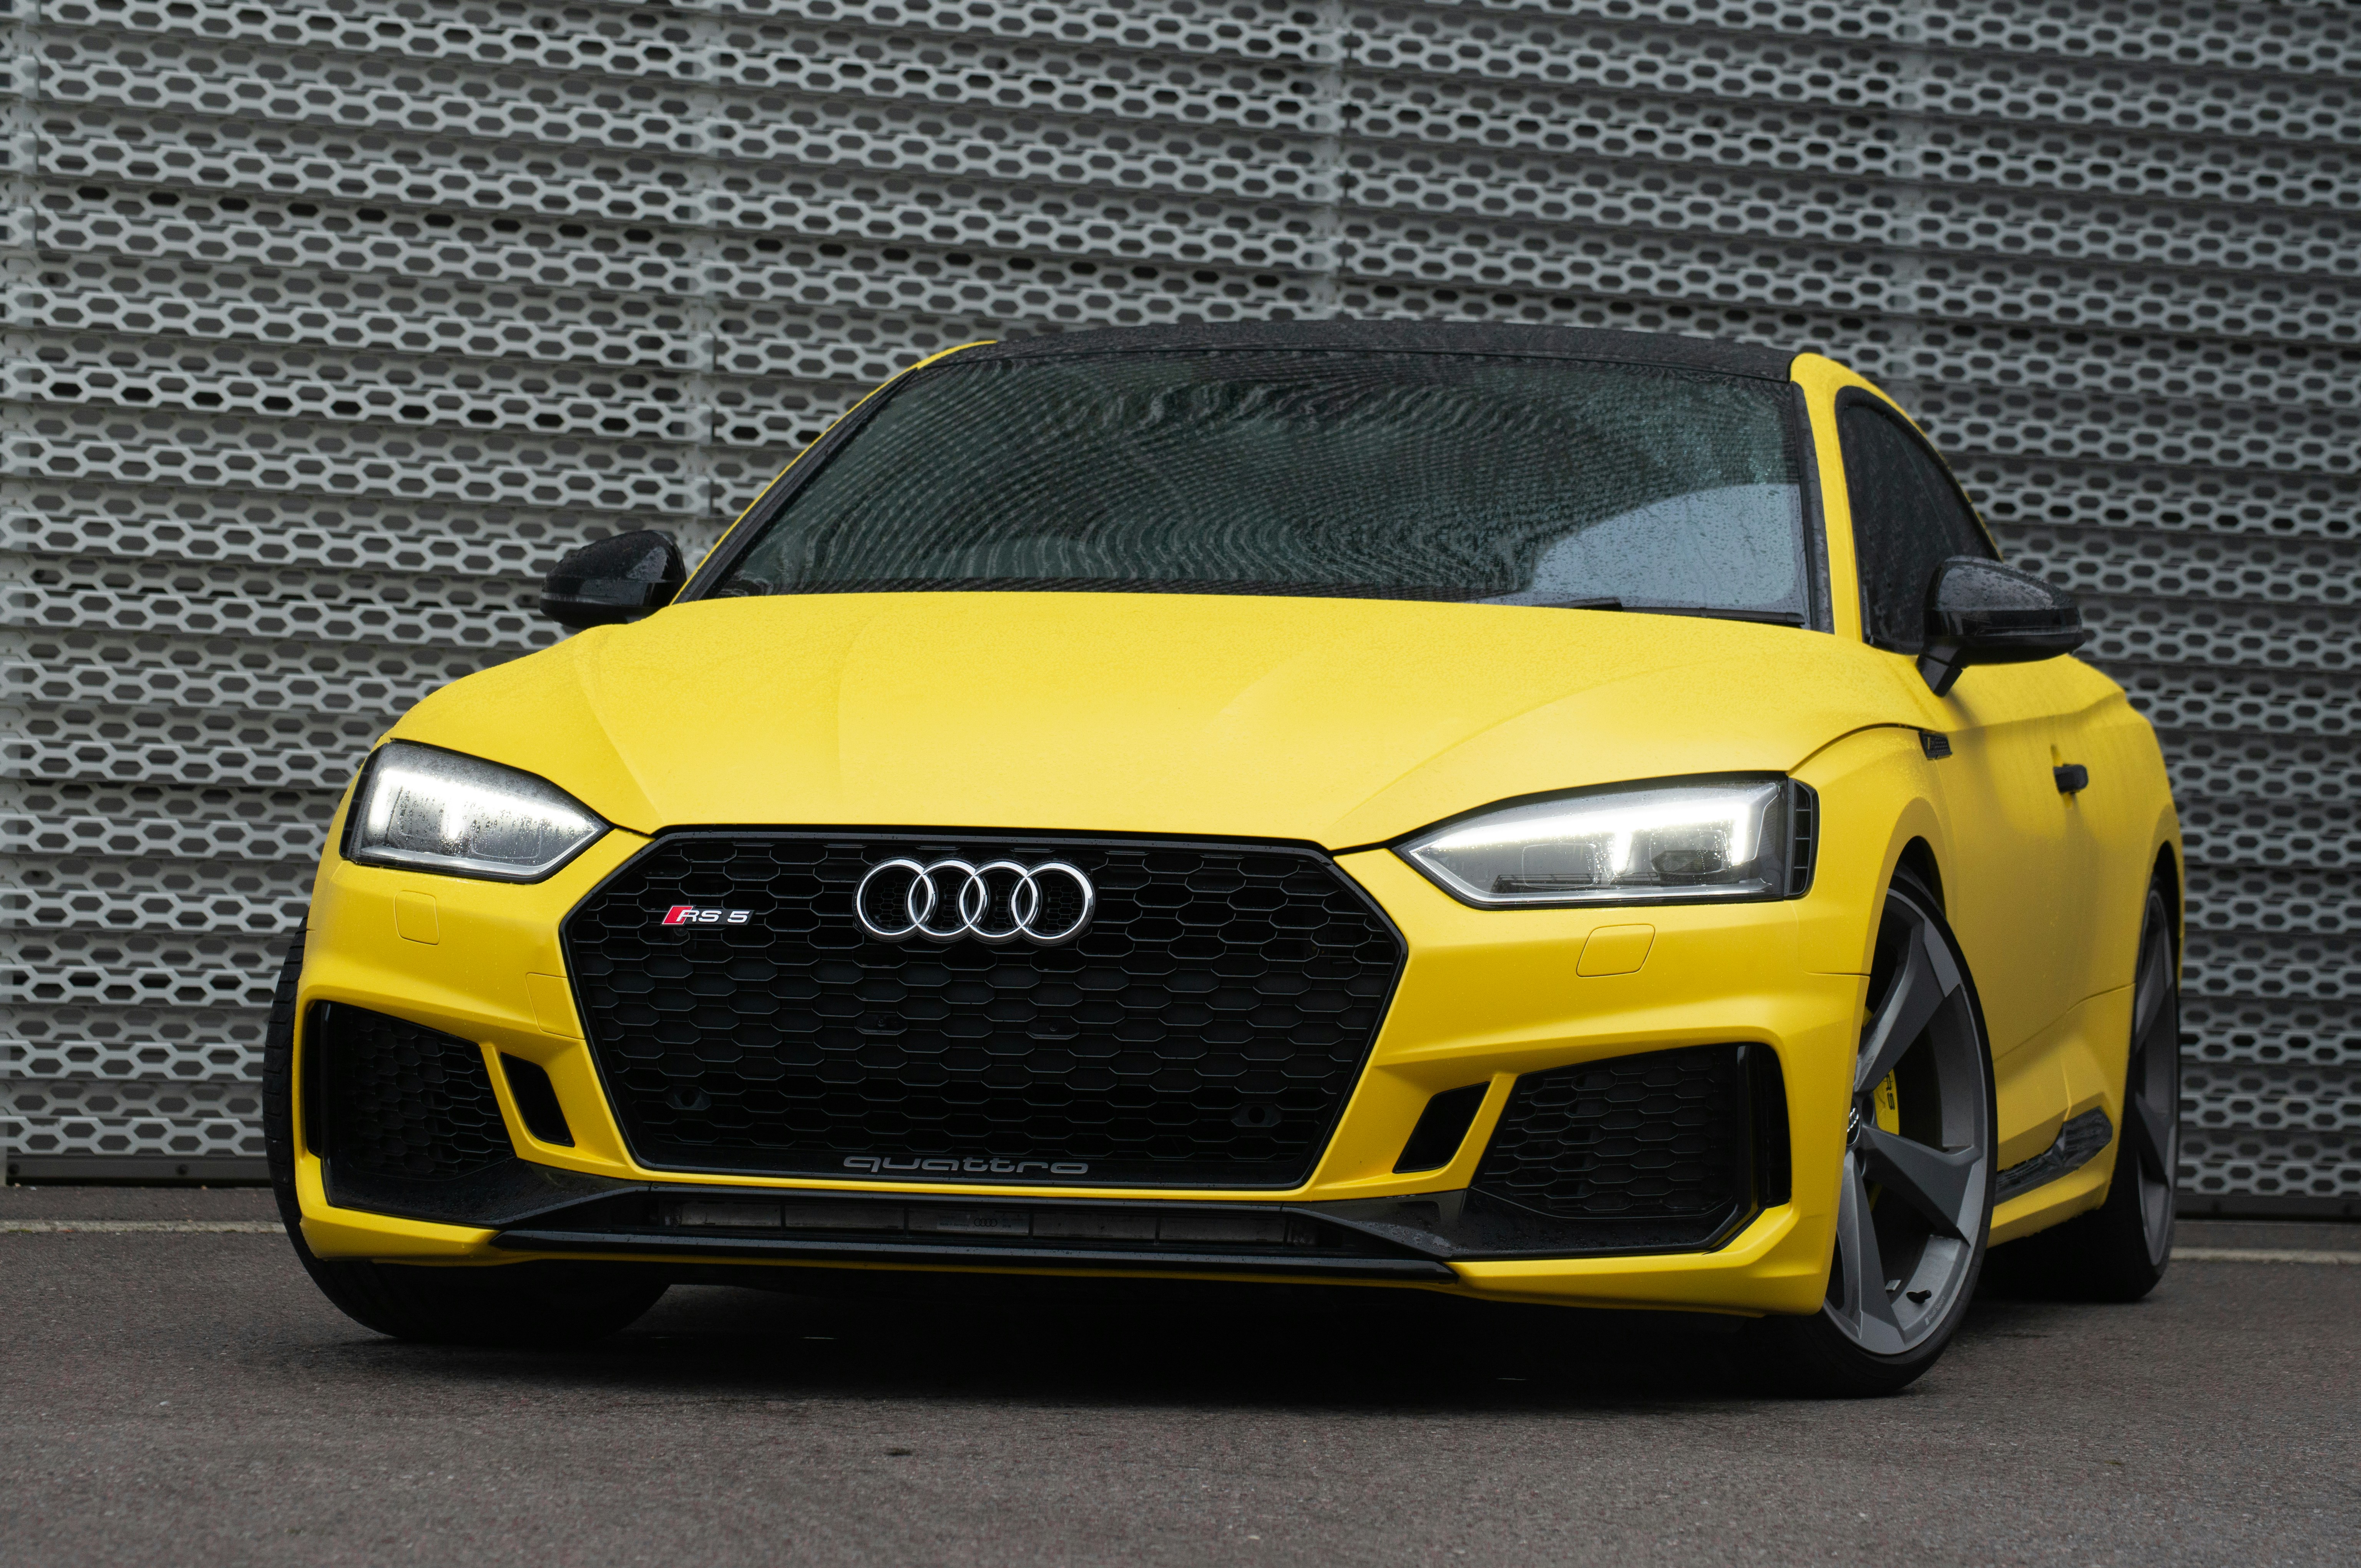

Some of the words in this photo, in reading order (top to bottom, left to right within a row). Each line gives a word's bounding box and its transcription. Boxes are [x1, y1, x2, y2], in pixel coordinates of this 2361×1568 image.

[676, 910, 722, 922] RS
[727, 911, 750, 923] 5
[1886, 1074, 1895, 1110] RS
[843, 1156, 1088, 1174] quattro
[1935, 1296, 1946, 1311] Sport
